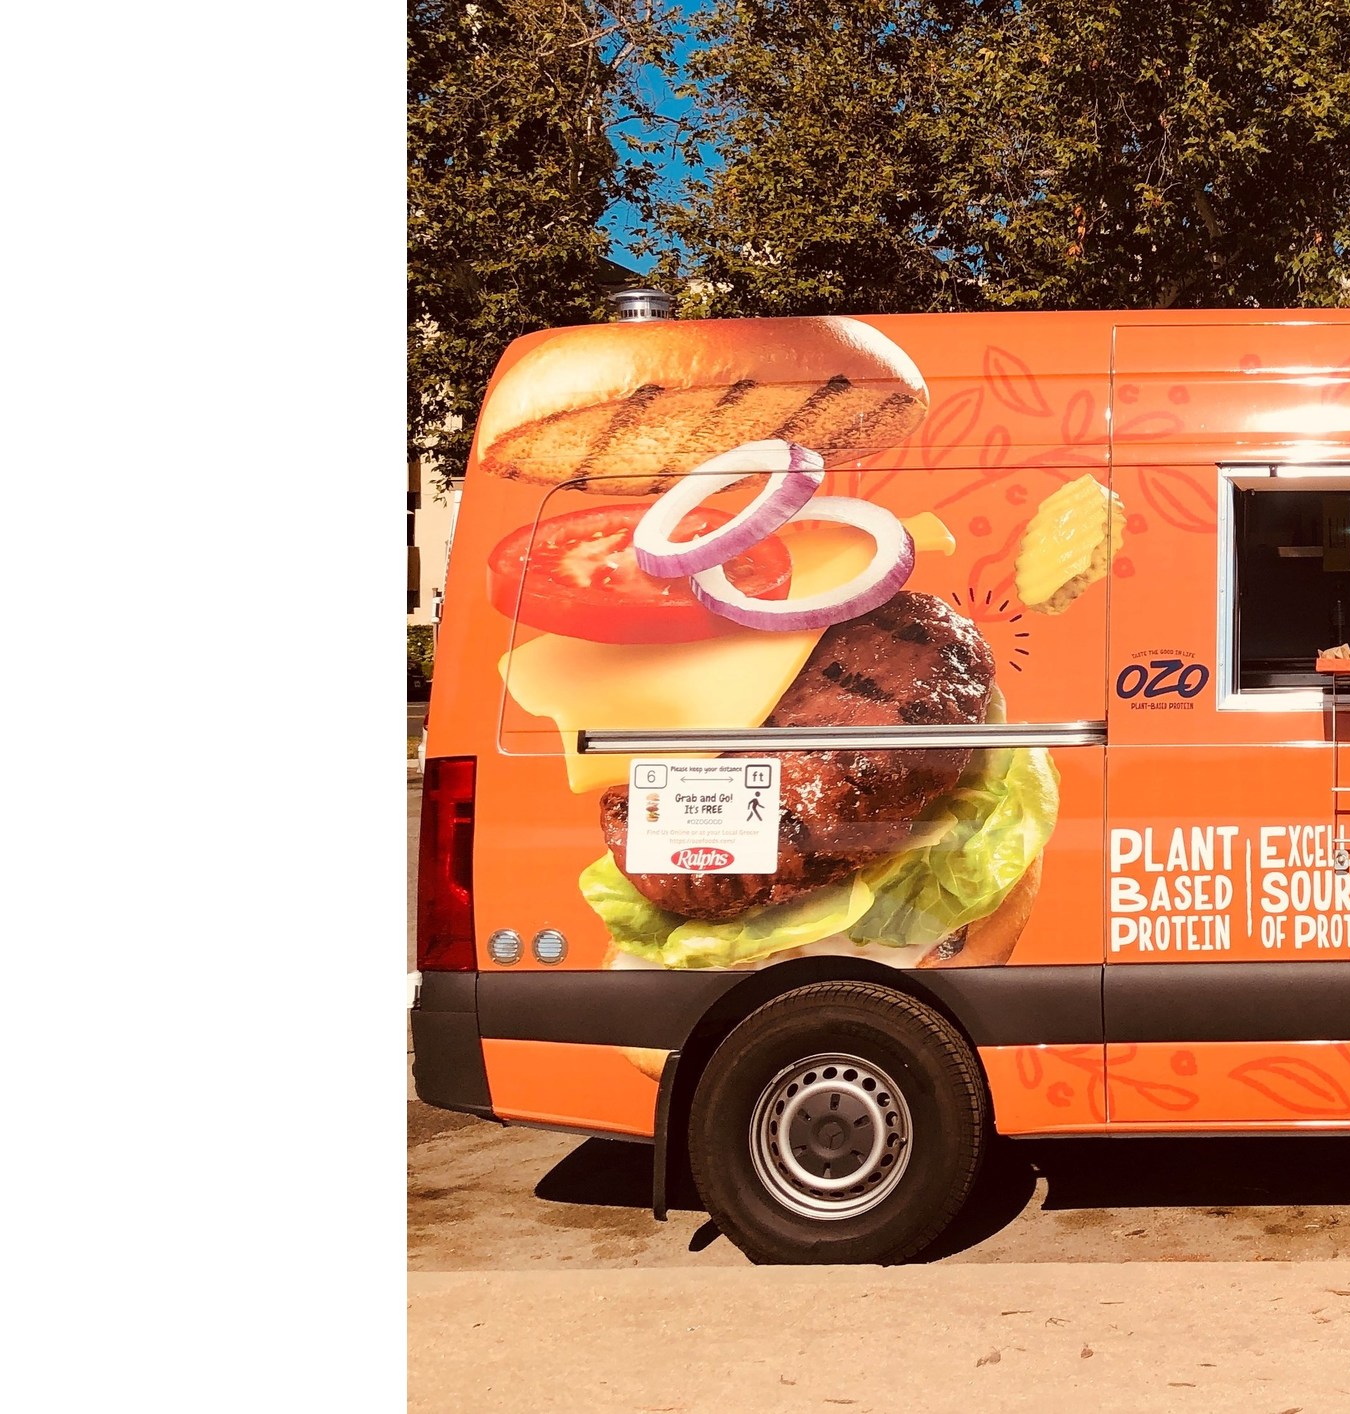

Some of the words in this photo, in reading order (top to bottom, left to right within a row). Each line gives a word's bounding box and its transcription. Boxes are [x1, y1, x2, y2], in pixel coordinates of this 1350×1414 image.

[1132, 650, 1147, 659] TASTE
[1183, 651, 1196, 659] LIFE
[1116, 659, 1210, 699] OZO
[1131, 702, 1167, 710] PLANT-BASED
[1169, 702, 1194, 710] PROTEIN
[647, 770, 656, 783] 6
[752, 771, 764, 782] ft
[675, 793, 697, 802] Grab
[700, 793, 716, 802] and
[719, 793, 733, 802] Go!
[684, 805, 698, 814] It's
[701, 805, 723, 814] FREE
[1110, 826, 1239, 873] PLANT
[677, 850, 728, 869] Ralphs
[1110, 875, 1233, 913] BASED
[1110, 914, 1231, 952] PROTEIN
[1261, 915, 1287, 949] OF
